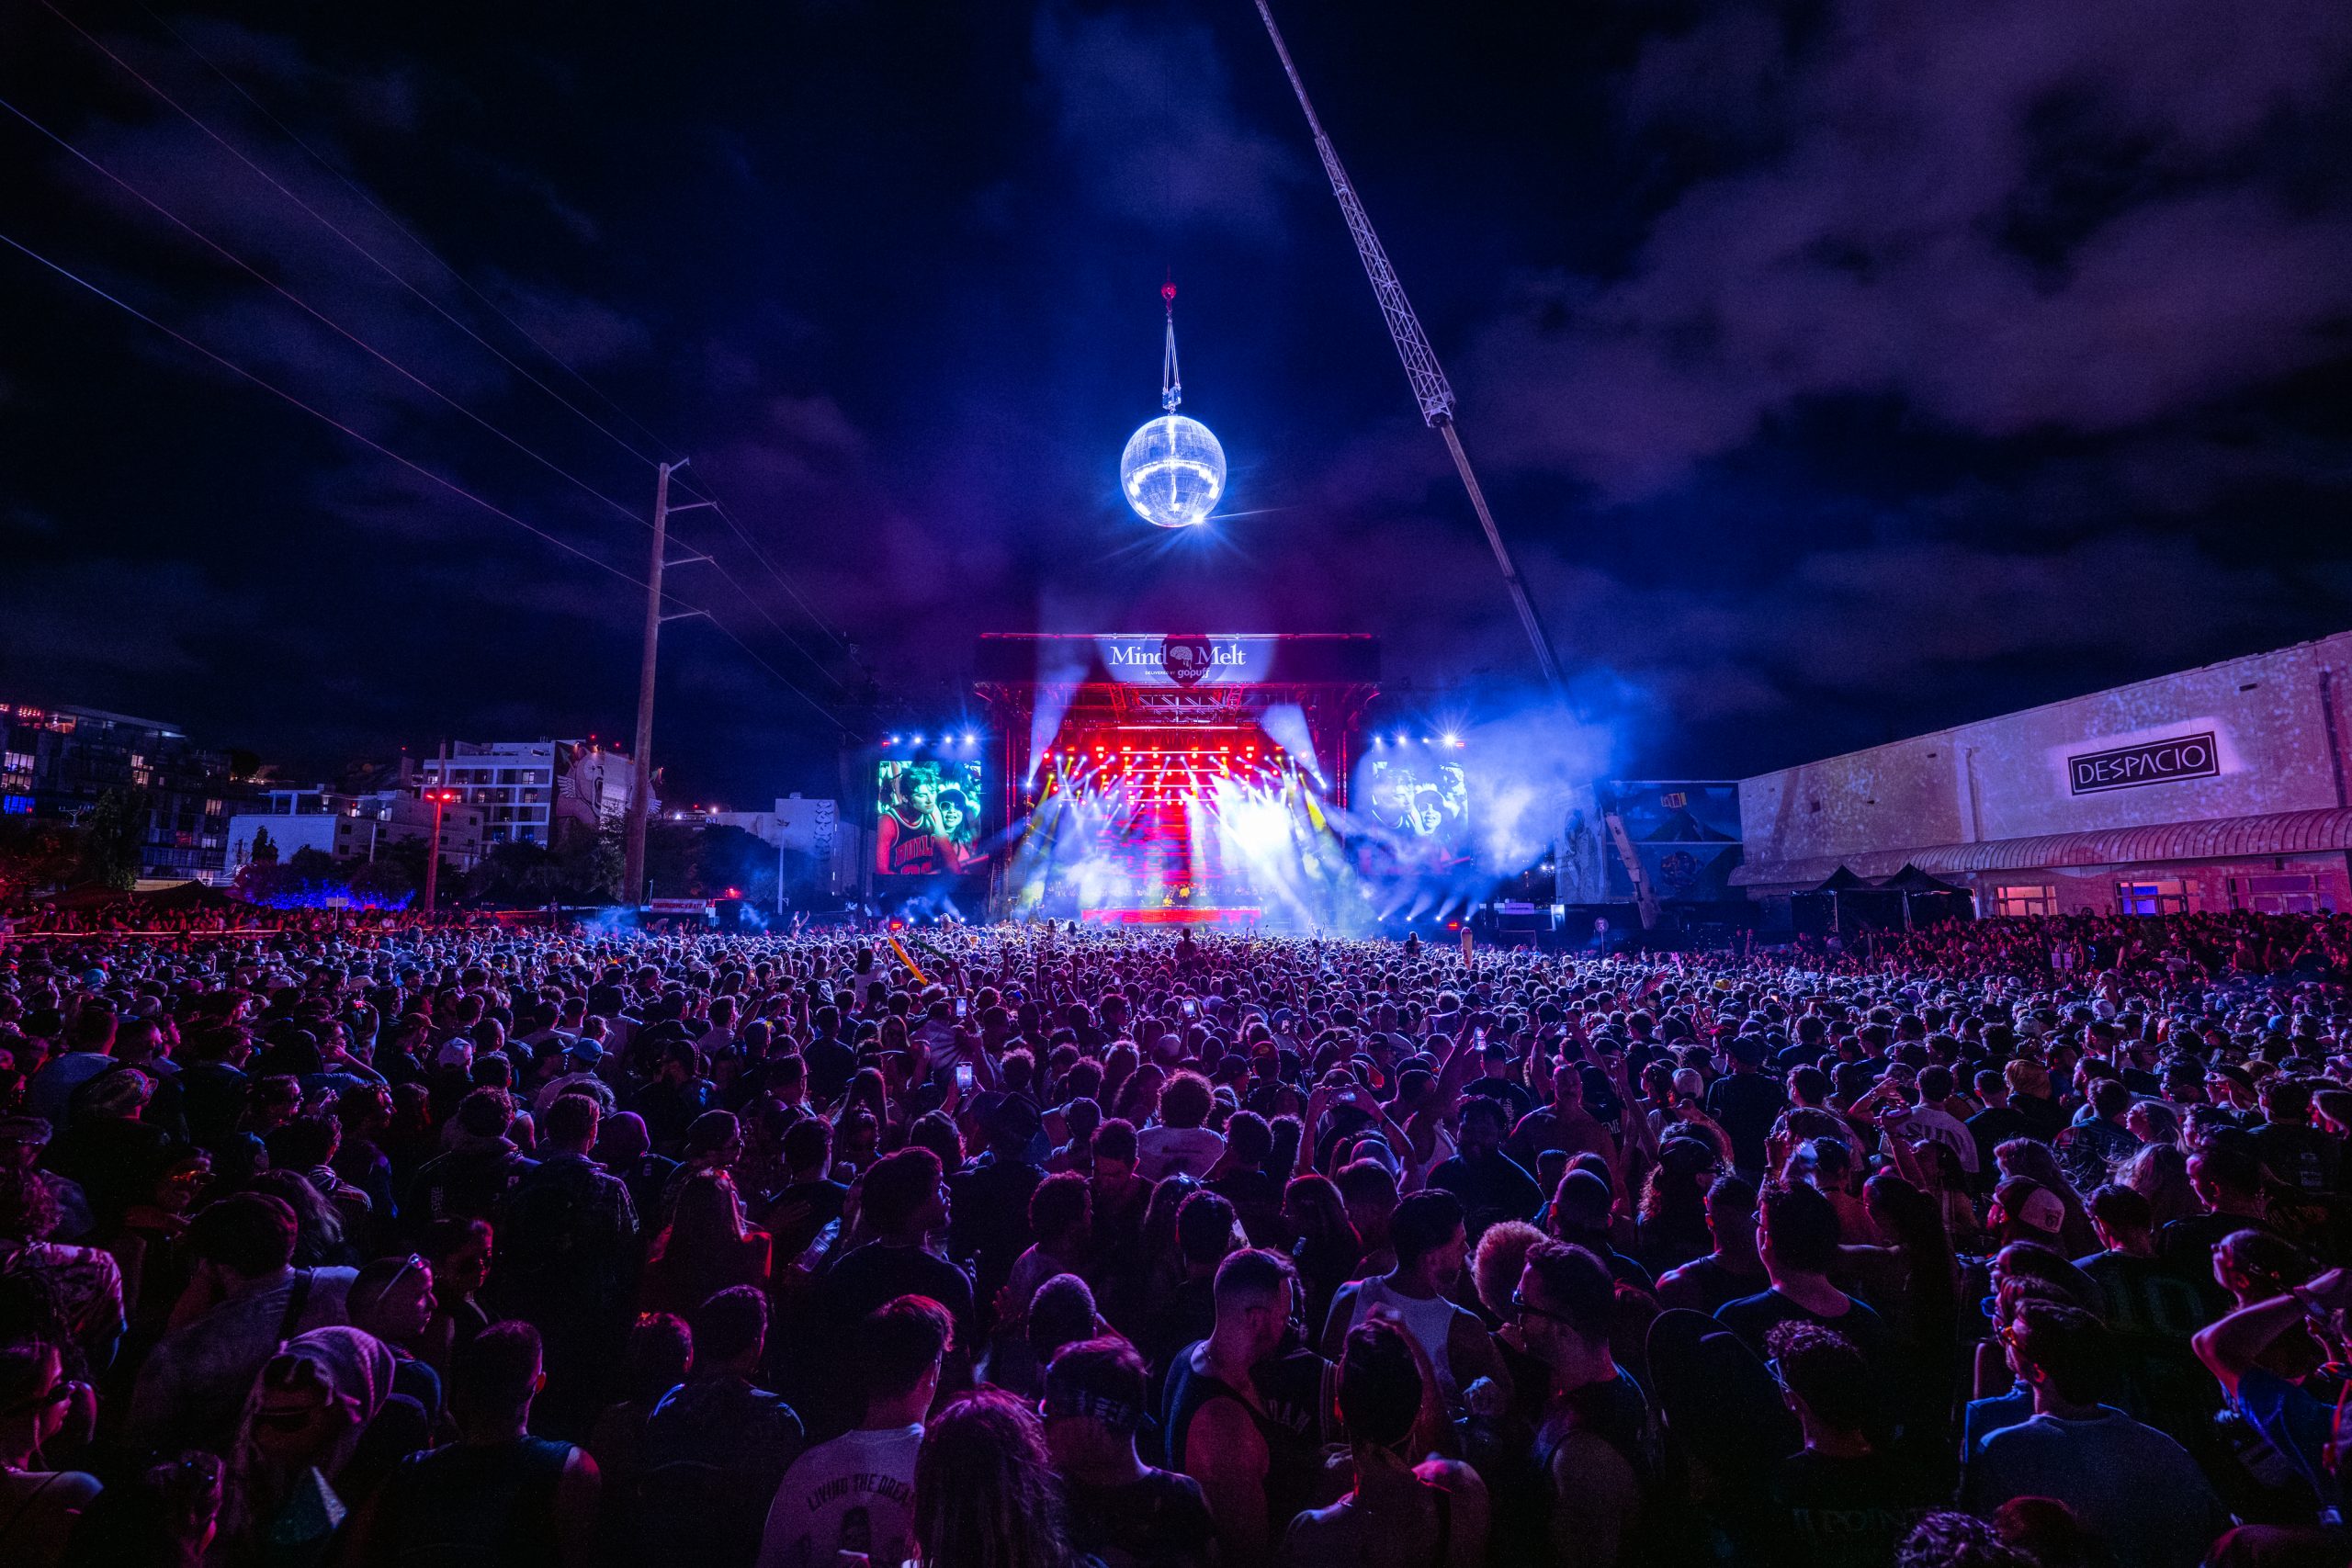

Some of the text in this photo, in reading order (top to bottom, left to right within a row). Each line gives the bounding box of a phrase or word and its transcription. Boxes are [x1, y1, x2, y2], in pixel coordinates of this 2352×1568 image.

[1108, 643, 1247, 665] Mind Melt
[1177, 668, 1211, 679] gopuff
[2077, 745, 2206, 784] DESPACIO
[854, 1473, 877, 1493] THE
